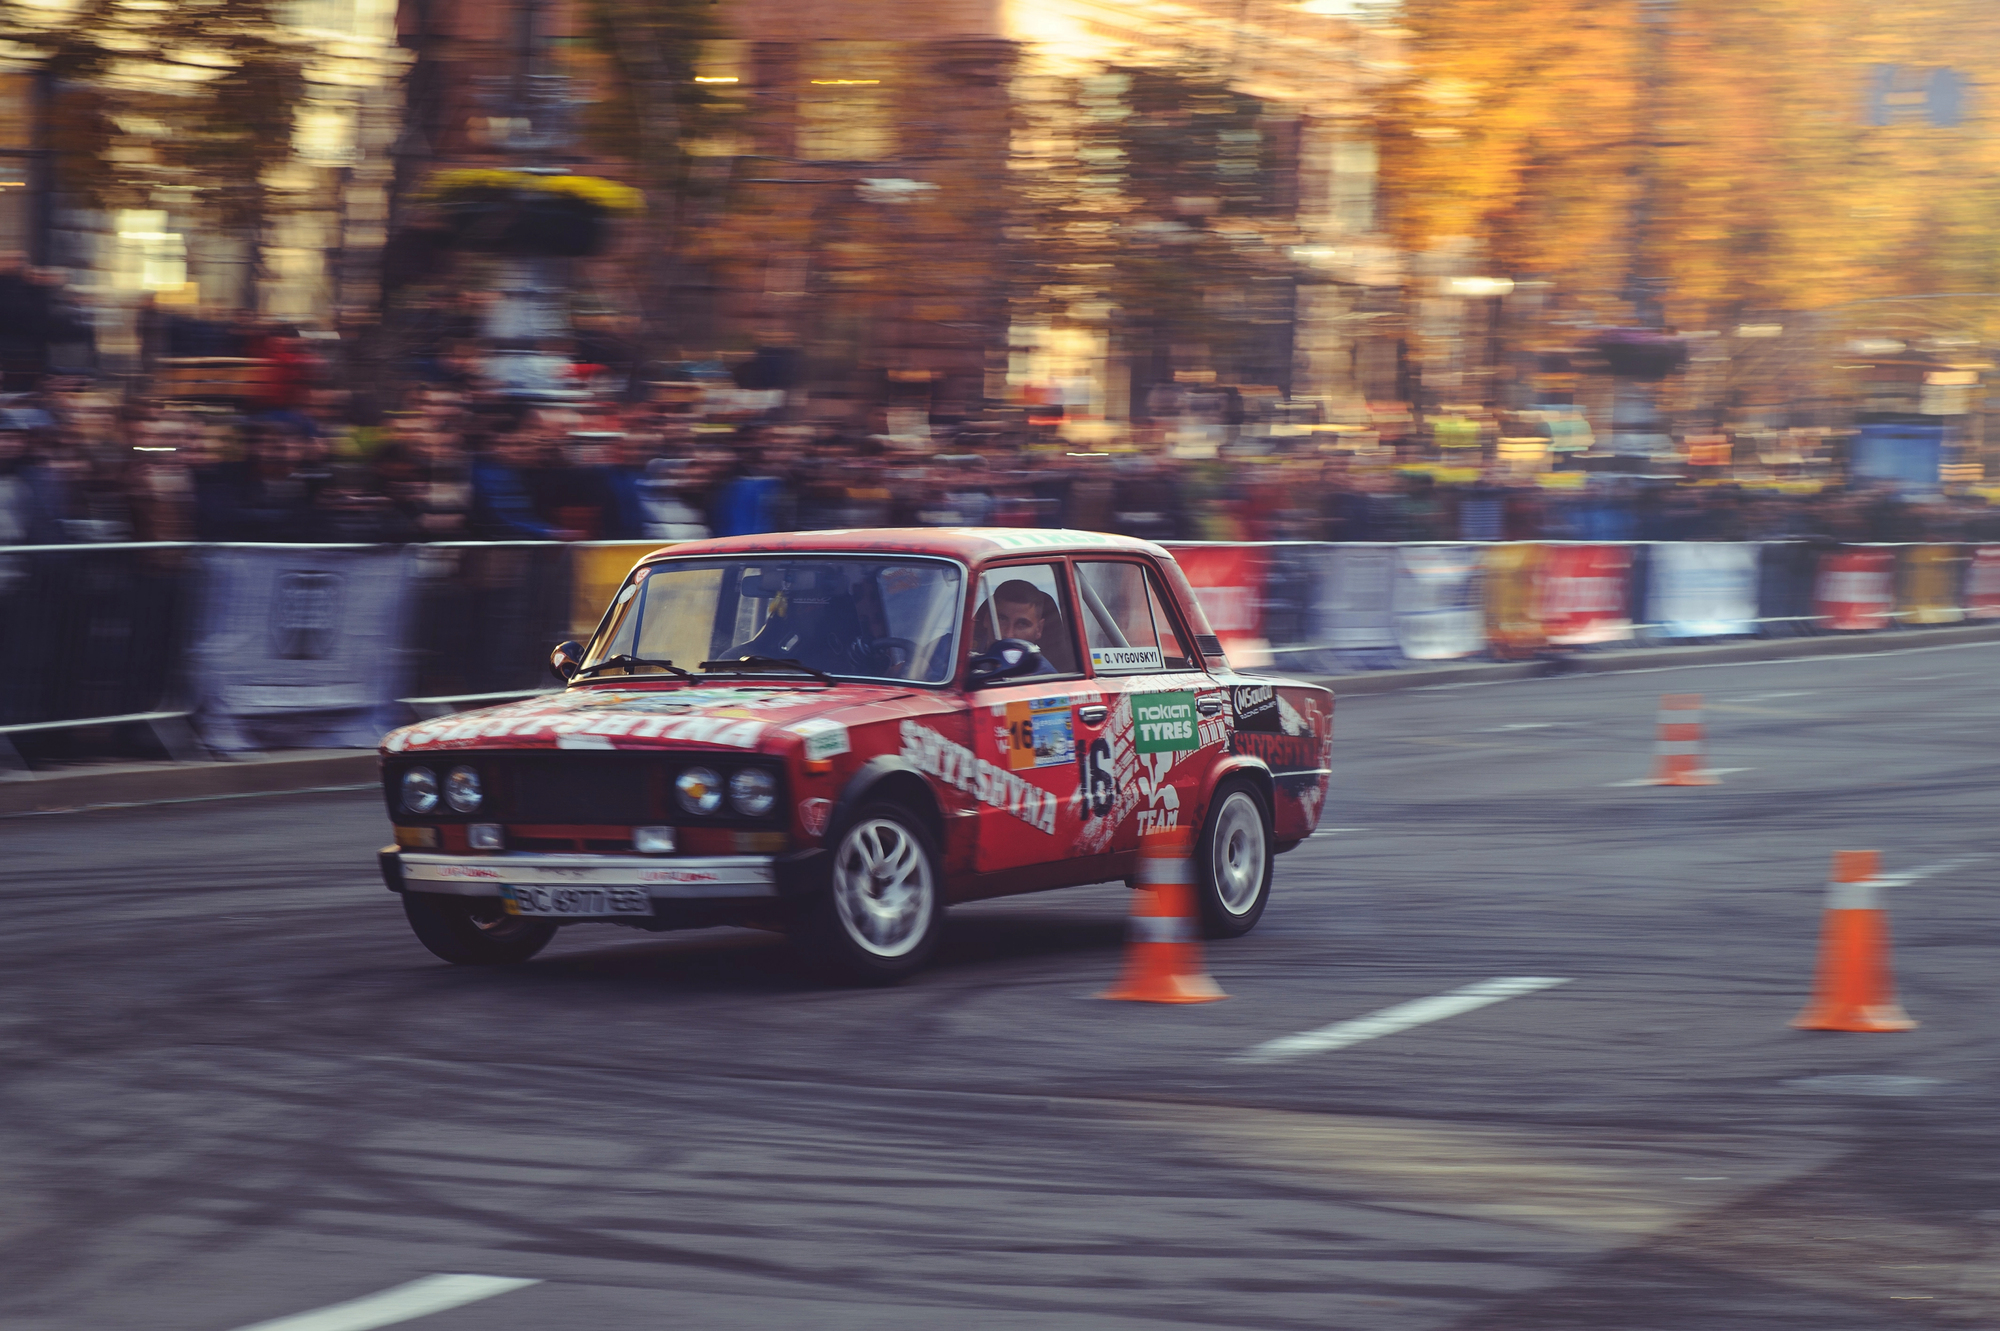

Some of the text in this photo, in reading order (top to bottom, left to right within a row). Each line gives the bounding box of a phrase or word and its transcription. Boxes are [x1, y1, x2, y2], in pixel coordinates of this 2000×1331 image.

[1104, 651, 1158, 664] O. VYGOVSKYI
[1137, 704, 1192, 721] nokian
[1010, 720, 1033, 750] 16
[1139, 721, 1193, 742] TYRES
[1078, 738, 1114, 821] 16
[1137, 808, 1179, 837] TEAM
